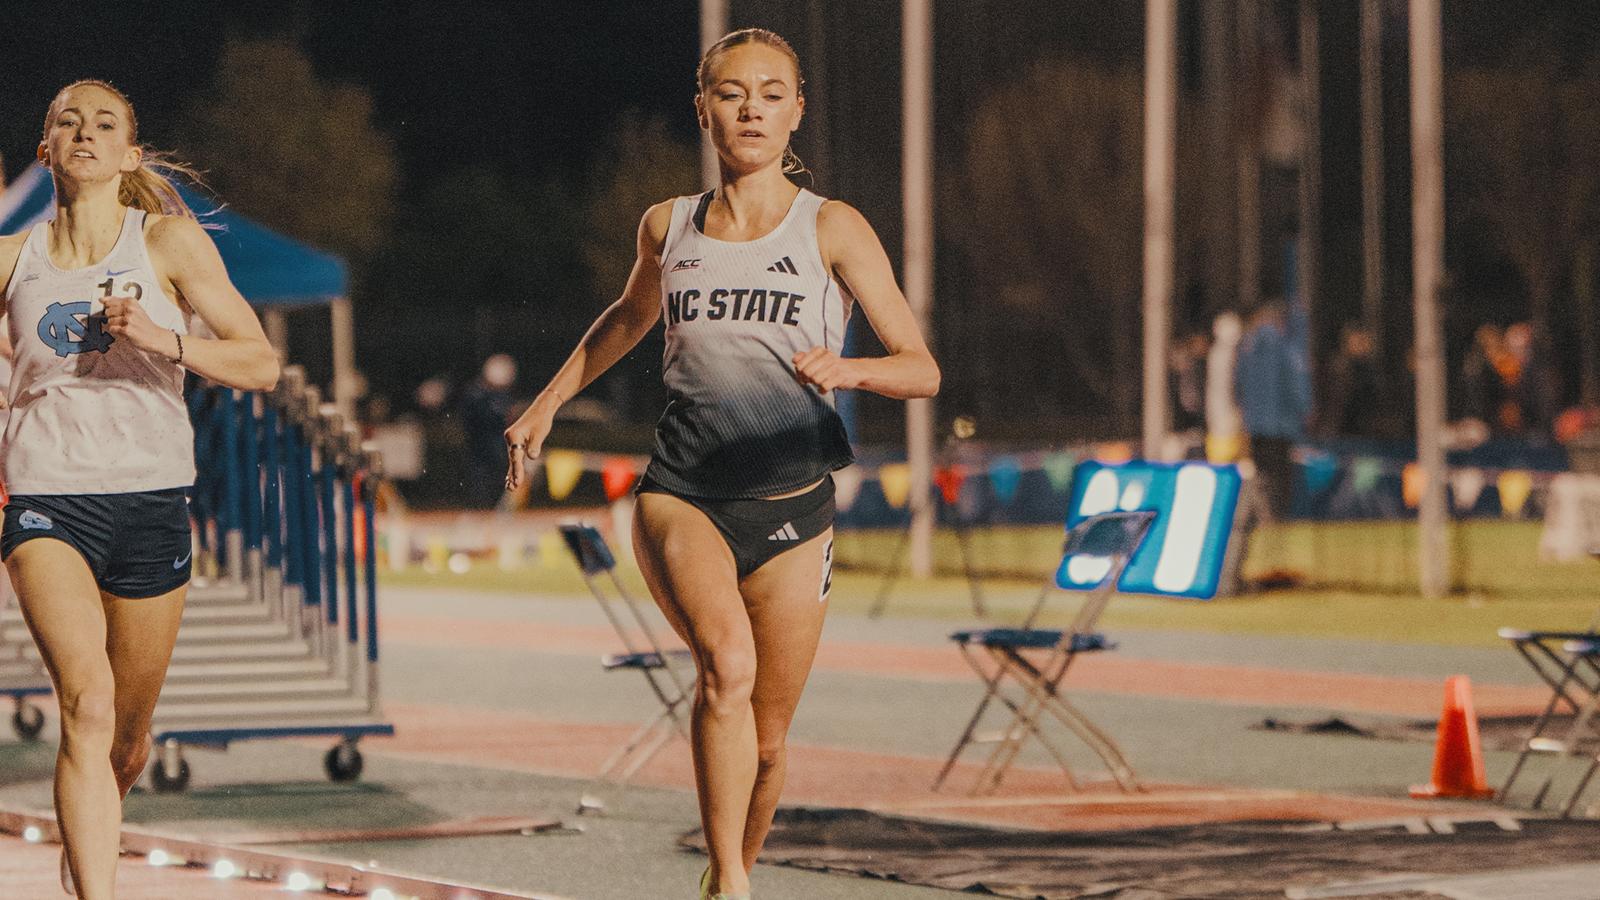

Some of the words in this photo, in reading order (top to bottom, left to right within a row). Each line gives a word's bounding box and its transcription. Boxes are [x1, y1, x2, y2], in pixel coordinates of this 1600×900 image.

[671, 259, 702, 272] ACC
[668, 289, 700, 326] NC
[707, 288, 806, 326] STATE
